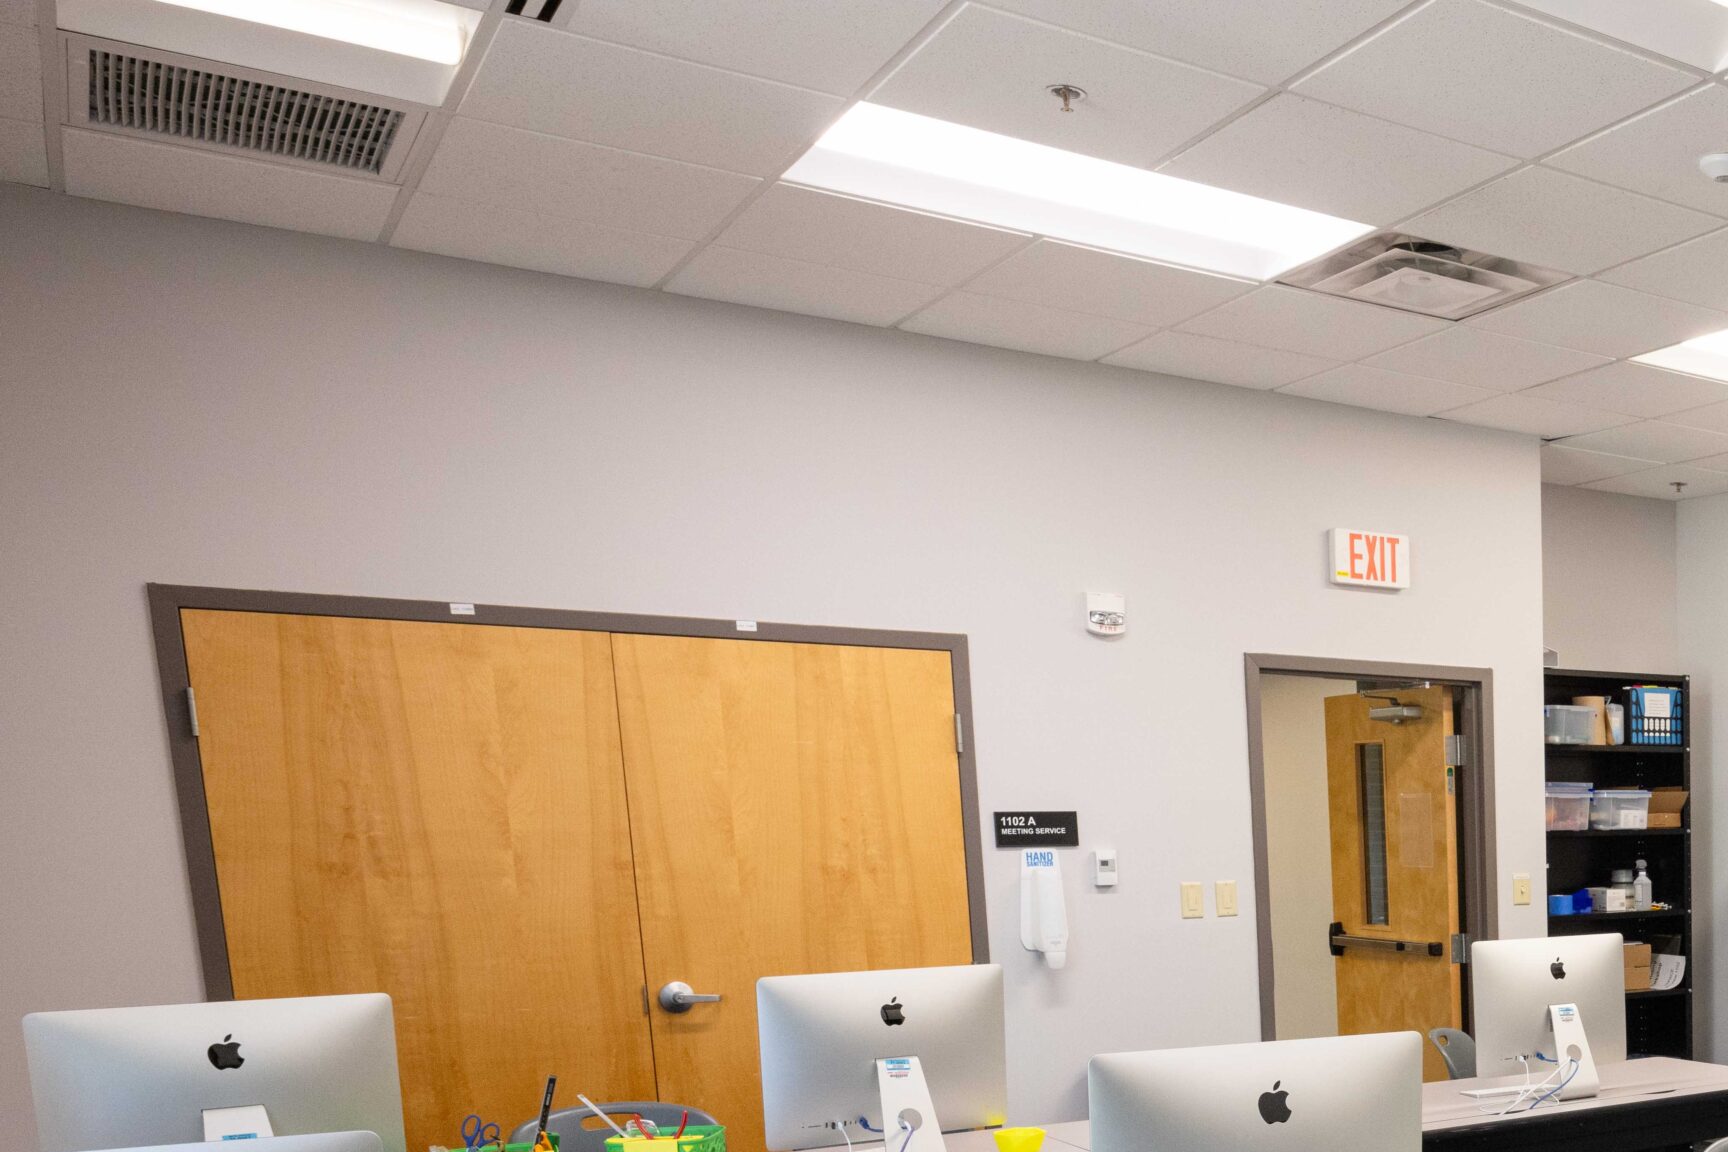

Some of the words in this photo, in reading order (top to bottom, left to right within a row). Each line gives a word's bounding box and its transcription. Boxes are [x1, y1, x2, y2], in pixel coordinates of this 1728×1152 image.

[1349, 533, 1399, 583] EXIT
[1000, 816, 1025, 826] 1102
[1028, 816, 1036, 826] A
[1026, 852, 1053, 862] HAND
